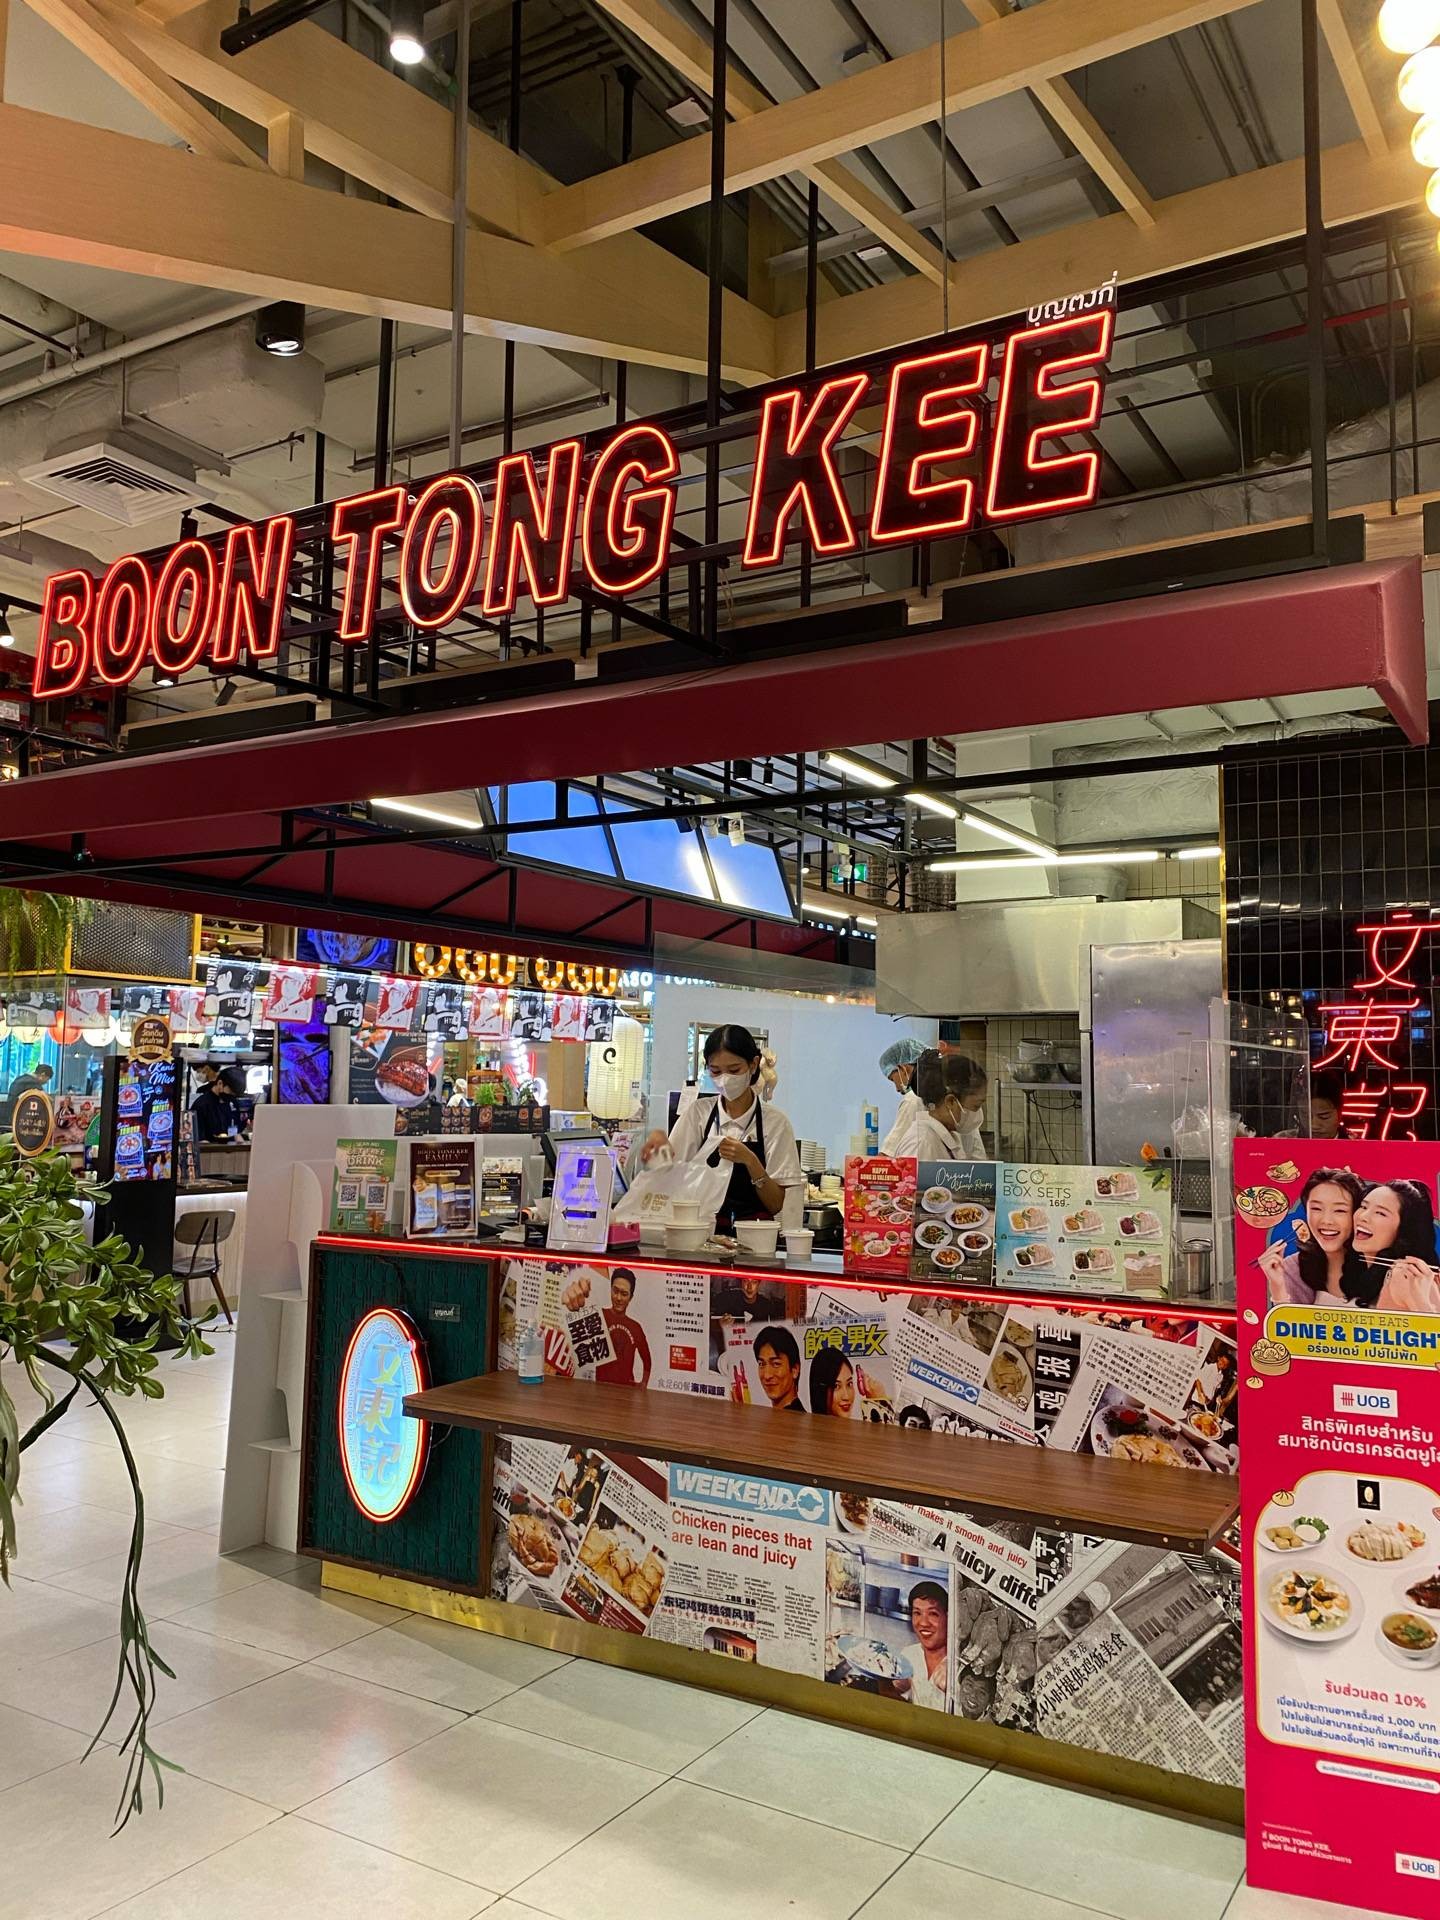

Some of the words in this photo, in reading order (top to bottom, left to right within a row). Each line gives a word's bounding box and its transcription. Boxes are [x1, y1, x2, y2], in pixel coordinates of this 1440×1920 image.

[1027, 270, 1118, 327] บุญตงกี่
[31, 514, 295, 700] BOON
[330, 423, 682, 643] TONG
[742, 308, 1113, 569] KEE
[347, 1156, 386, 1167] DRINK
[425, 1154, 461, 1162] FAMILY
[871, 1167, 889, 1175] HAPPY
[936, 1164, 975, 1186] Original
[1002, 1168, 1045, 1185] ECO
[1002, 1185, 1032, 1199] BOX
[1037, 1186, 1072, 1200] SETS
[1313, 1312, 1375, 1326] GOURMET
[1379, 1317, 1410, 1328] EATS
[803, 1323, 890, 1360] 飲食男女
[1275, 1321, 1327, 1339] DINE
[1332, 1325, 1346, 1342] &
[1353, 1326, 1440, 1349] DELIGH
[574, 1336, 610, 1368] 食物
[1307, 1343, 1360, 1356] อร่อยเดย์
[1364, 1345, 1418, 1361] เปย์ไม่พัก
[908, 1361, 966, 1397] WEEKEND
[1356, 1394, 1391, 1409] UOB
[1301, 1415, 1434, 1444] สิทธิพิเศษสำหรับ
[676, 1469, 797, 1506] WEEKEND
[671, 1509, 727, 1534] Chicken
[731, 1522, 780, 1545] pieces
[784, 1532, 813, 1551] that
[917, 1505, 945, 1526] makes
[945, 1517, 954, 1530] it
[954, 1523, 985, 1547] smooth
[987, 1541, 1004, 1556] and
[1006, 1551, 1028, 1569] juicy
[671, 1531, 694, 1546] are
[697, 1533, 727, 1553] lean
[732, 1540, 759, 1559] and
[762, 1547, 798, 1570] juicy
[932, 1531, 947, 1552] A
[952, 1541, 996, 1584] juicy
[663, 1595, 755, 1623] 东记鸡饭独领风骚
[1324, 1679, 1389, 1703] รับส่วนลด
[1394, 1693, 1427, 1709] 10%
[1388, 1716, 1415, 1729] 1,000
[1419, 1722, 1437, 1732] บาท
[1268, 1832, 1290, 1843] BOON
[1291, 1837, 1313, 1849] TONG
[1411, 1860, 1436, 1875] UOB
